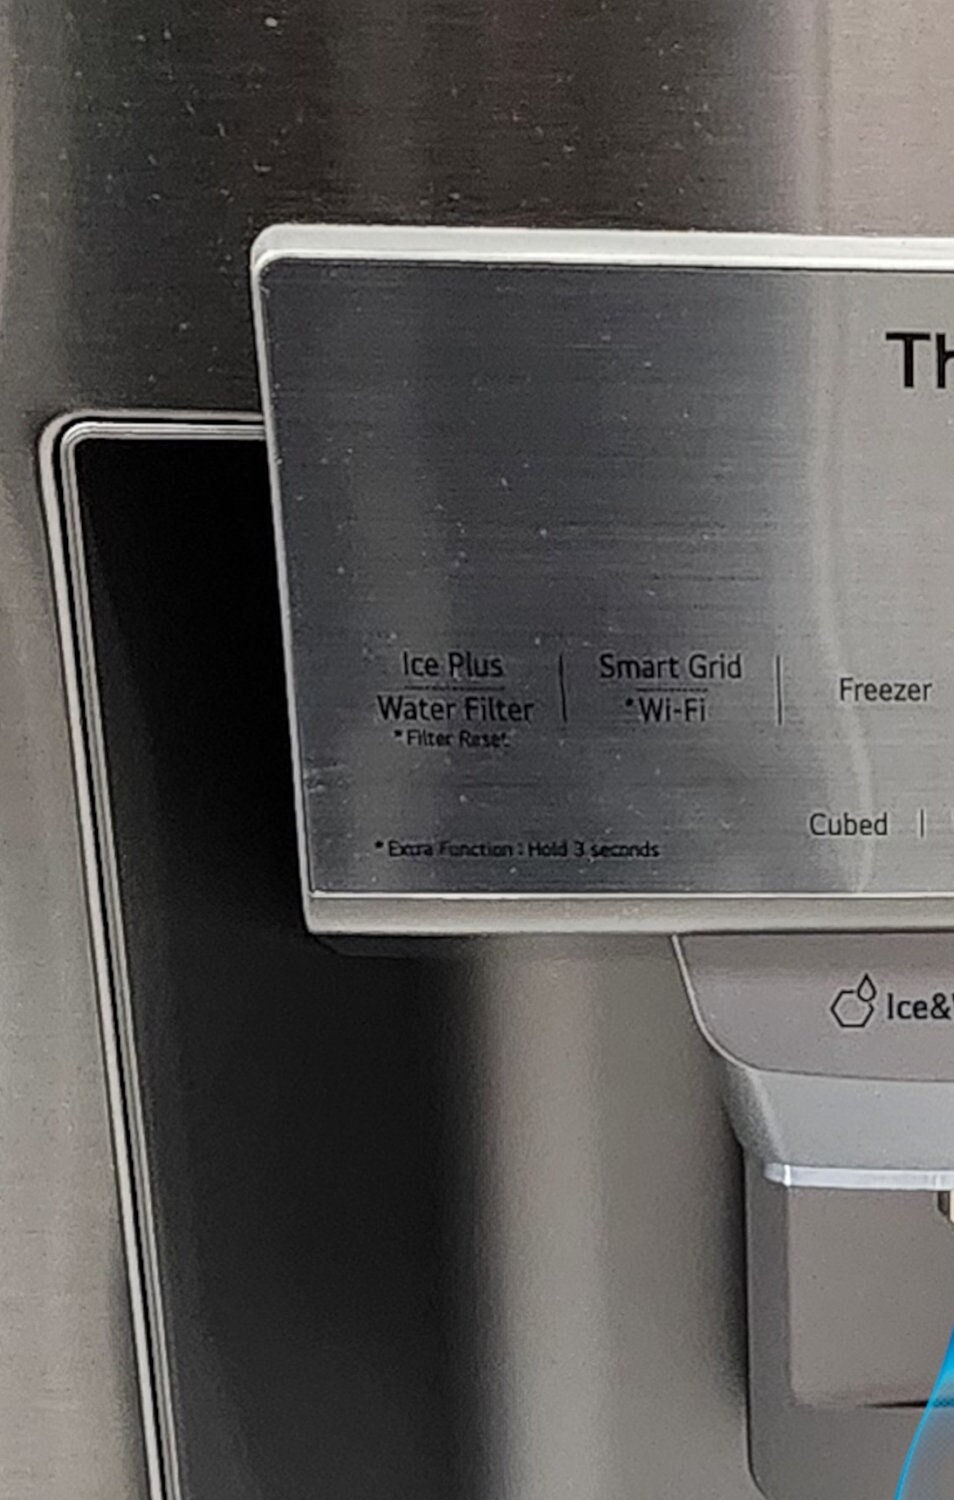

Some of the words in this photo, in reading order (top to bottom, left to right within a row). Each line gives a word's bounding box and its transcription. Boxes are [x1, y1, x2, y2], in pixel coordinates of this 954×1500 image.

[403, 651, 440, 677] Ice
[449, 651, 504, 678] Plus
[600, 653, 680, 680] Smart
[689, 653, 742, 680] Grid
[839, 677, 933, 703] Freezer
[377, 695, 457, 721] Water
[465, 696, 535, 722] Filter
[458, 729, 511, 748] Reset
[809, 812, 889, 837] Cubed
[573, 840, 585, 857] 3
[590, 841, 660, 858] seconds
